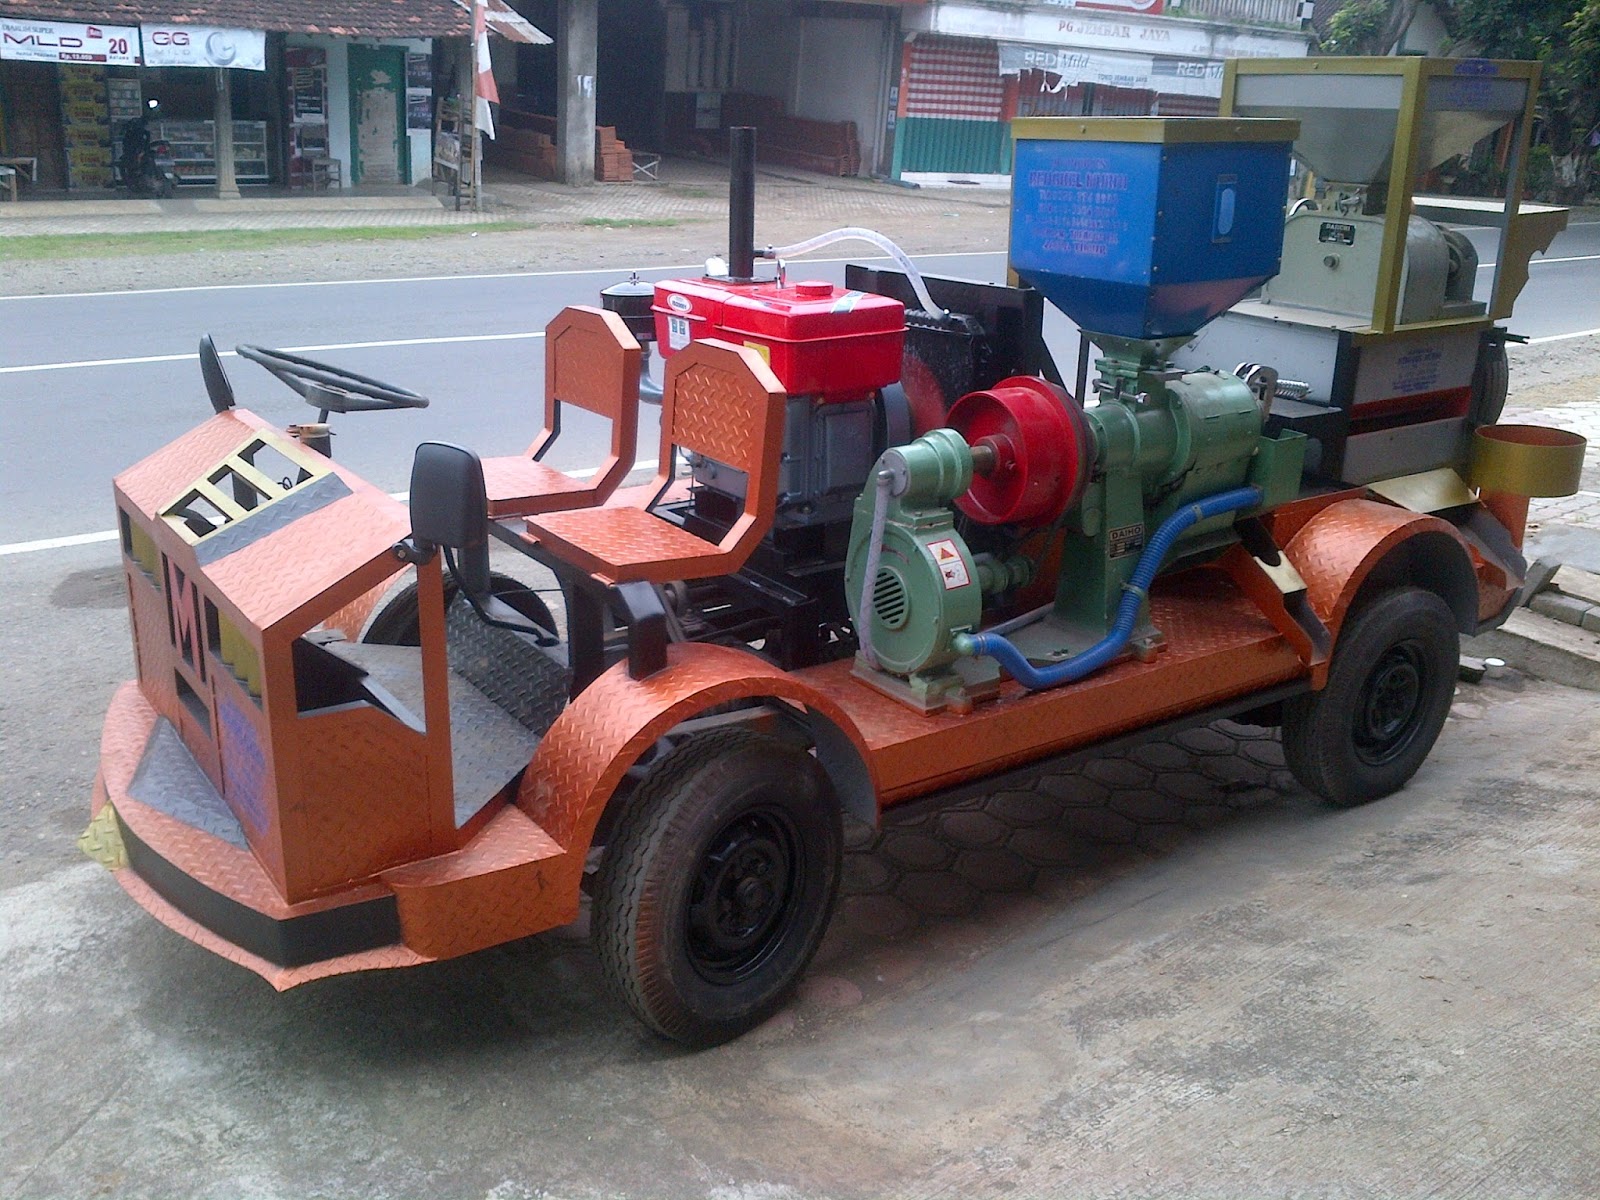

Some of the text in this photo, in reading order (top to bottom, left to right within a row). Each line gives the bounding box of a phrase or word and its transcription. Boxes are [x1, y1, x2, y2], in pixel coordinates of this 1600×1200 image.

[3, 32, 83, 48] MLD
[152, 31, 190, 46] GG
[1140, 28, 1171, 41] JAYA
[108, 38, 128, 54] 20
[1176, 61, 1205, 77] RED
[1112, 526, 1141, 540] DAIHO
